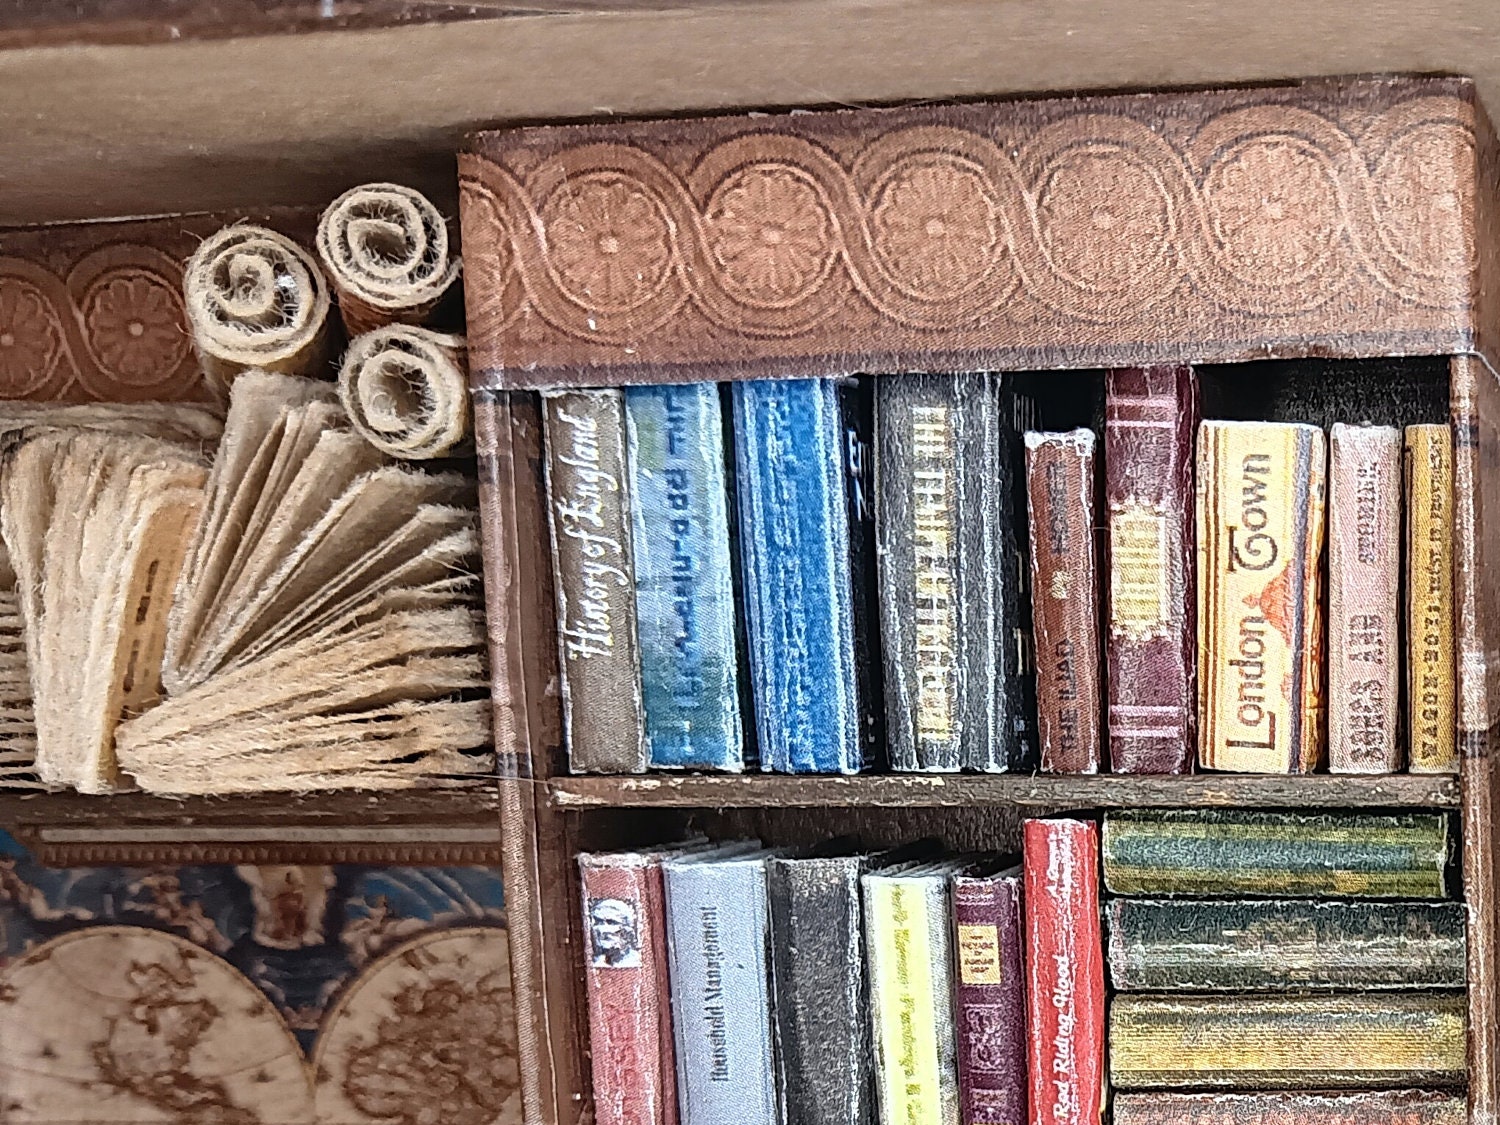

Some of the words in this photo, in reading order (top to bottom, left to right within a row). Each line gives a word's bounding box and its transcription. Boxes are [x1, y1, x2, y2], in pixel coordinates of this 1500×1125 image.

[556, 407, 618, 527] England
[564, 525, 623, 557] of
[1226, 454, 1278, 574] Town
[564, 562, 628, 660] History
[1055, 640, 1075, 700] ILIAD
[1225, 616, 1276, 750] London
[1058, 710, 1078, 753] THE
[699, 906, 724, 1002] Management
[1052, 953, 1070, 1008] Hood
[1052, 1014, 1073, 1075] Riding
